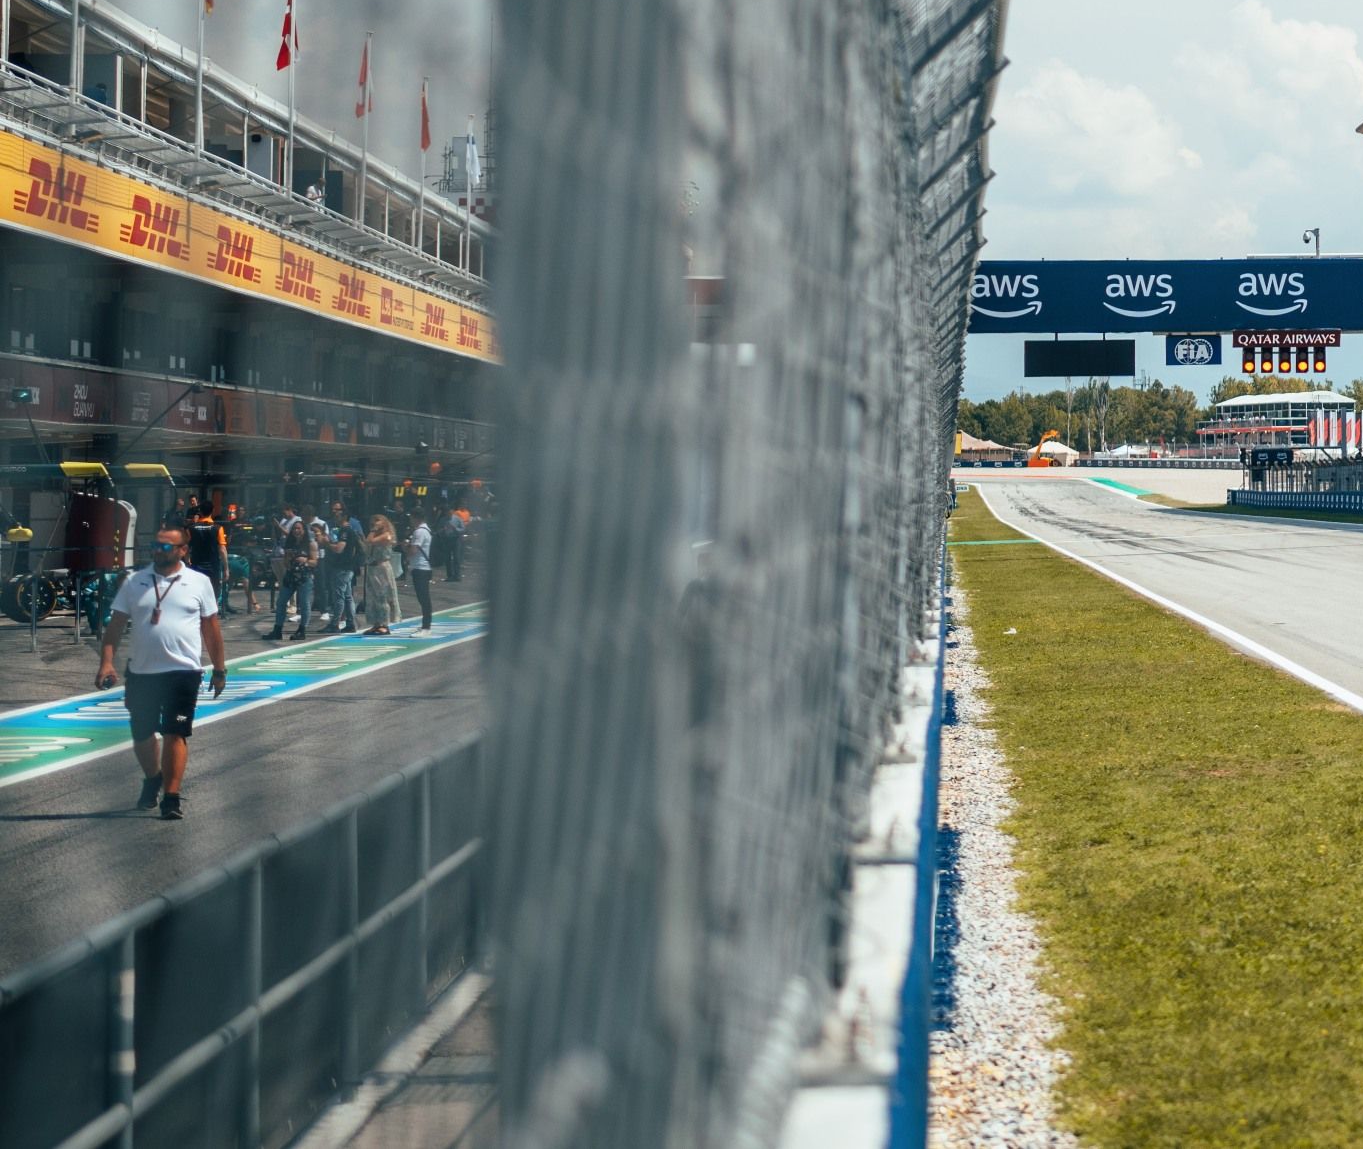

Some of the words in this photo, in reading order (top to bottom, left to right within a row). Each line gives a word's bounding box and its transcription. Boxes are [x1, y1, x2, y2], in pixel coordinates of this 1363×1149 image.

[25, 157, 88, 231] DHL
[131, 195, 183, 258] DHL
[214, 226, 255, 281] DHL
[282, 251, 317, 301] DHL
[338, 273, 367, 317] DHL
[971, 274, 1039, 298] aws
[1106, 274, 1172, 297] aws
[1239, 273, 1304, 296] aws
[424, 303, 446, 340] DHL
[1238, 334, 1279, 345] QATAR
[1283, 333, 1336, 344] AIRWAYS
[1177, 344, 1209, 359] FIA
